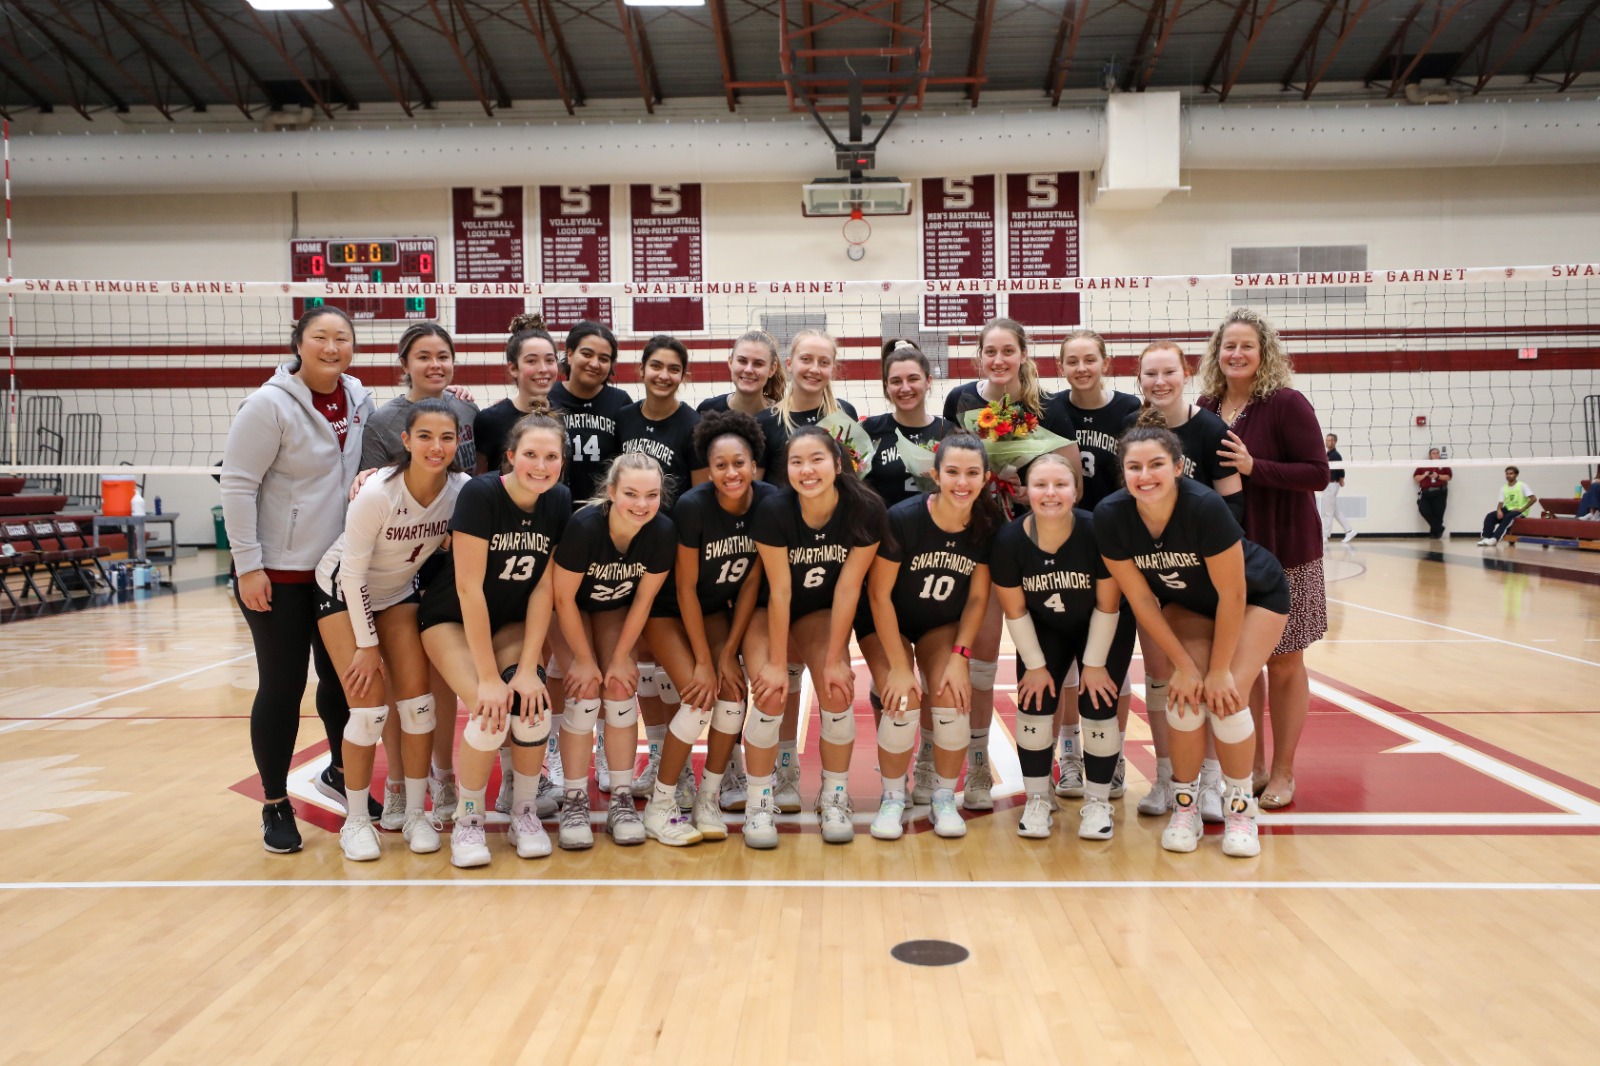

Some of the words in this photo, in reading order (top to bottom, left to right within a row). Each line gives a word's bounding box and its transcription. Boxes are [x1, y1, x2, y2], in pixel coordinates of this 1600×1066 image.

[462, 221, 515, 229] VOLLEYBALL
[549, 218, 602, 226] VOLLEYBALL
[296, 243, 322, 253] HOME
[400, 242, 434, 251] VISITOR
[1234, 272, 1373, 286] SWARTHMORE
[1386, 269, 1468, 283] GARNET
[1552, 264, 1600, 277] SWA
[25, 280, 159, 292] SWARTHMORE
[172, 282, 246, 293] GARNET
[325, 283, 457, 294] SWARTHMORE
[470, 283, 544, 294] GARNET
[624, 282, 757, 294] SWARTHMORE
[770, 282, 846, 293] GARNET
[926, 279, 1062, 291] SWARTHMORE
[1074, 277, 1152, 289] GARNET
[572, 434, 600, 461] 14
[1080, 450, 1095, 478] 3
[386, 520, 448, 541] SWARTHMO
[404, 543, 424, 562] 1
[705, 535, 757, 560] SWARTHM
[499, 555, 536, 580] 13
[715, 558, 749, 584] 19
[803, 566, 826, 588] 6
[919, 574, 956, 601] 10
[1022, 570, 1091, 592] SWARTHMORE
[1158, 571, 1187, 589] 5
[590, 581, 633, 601] 22
[1044, 592, 1066, 613] 4
